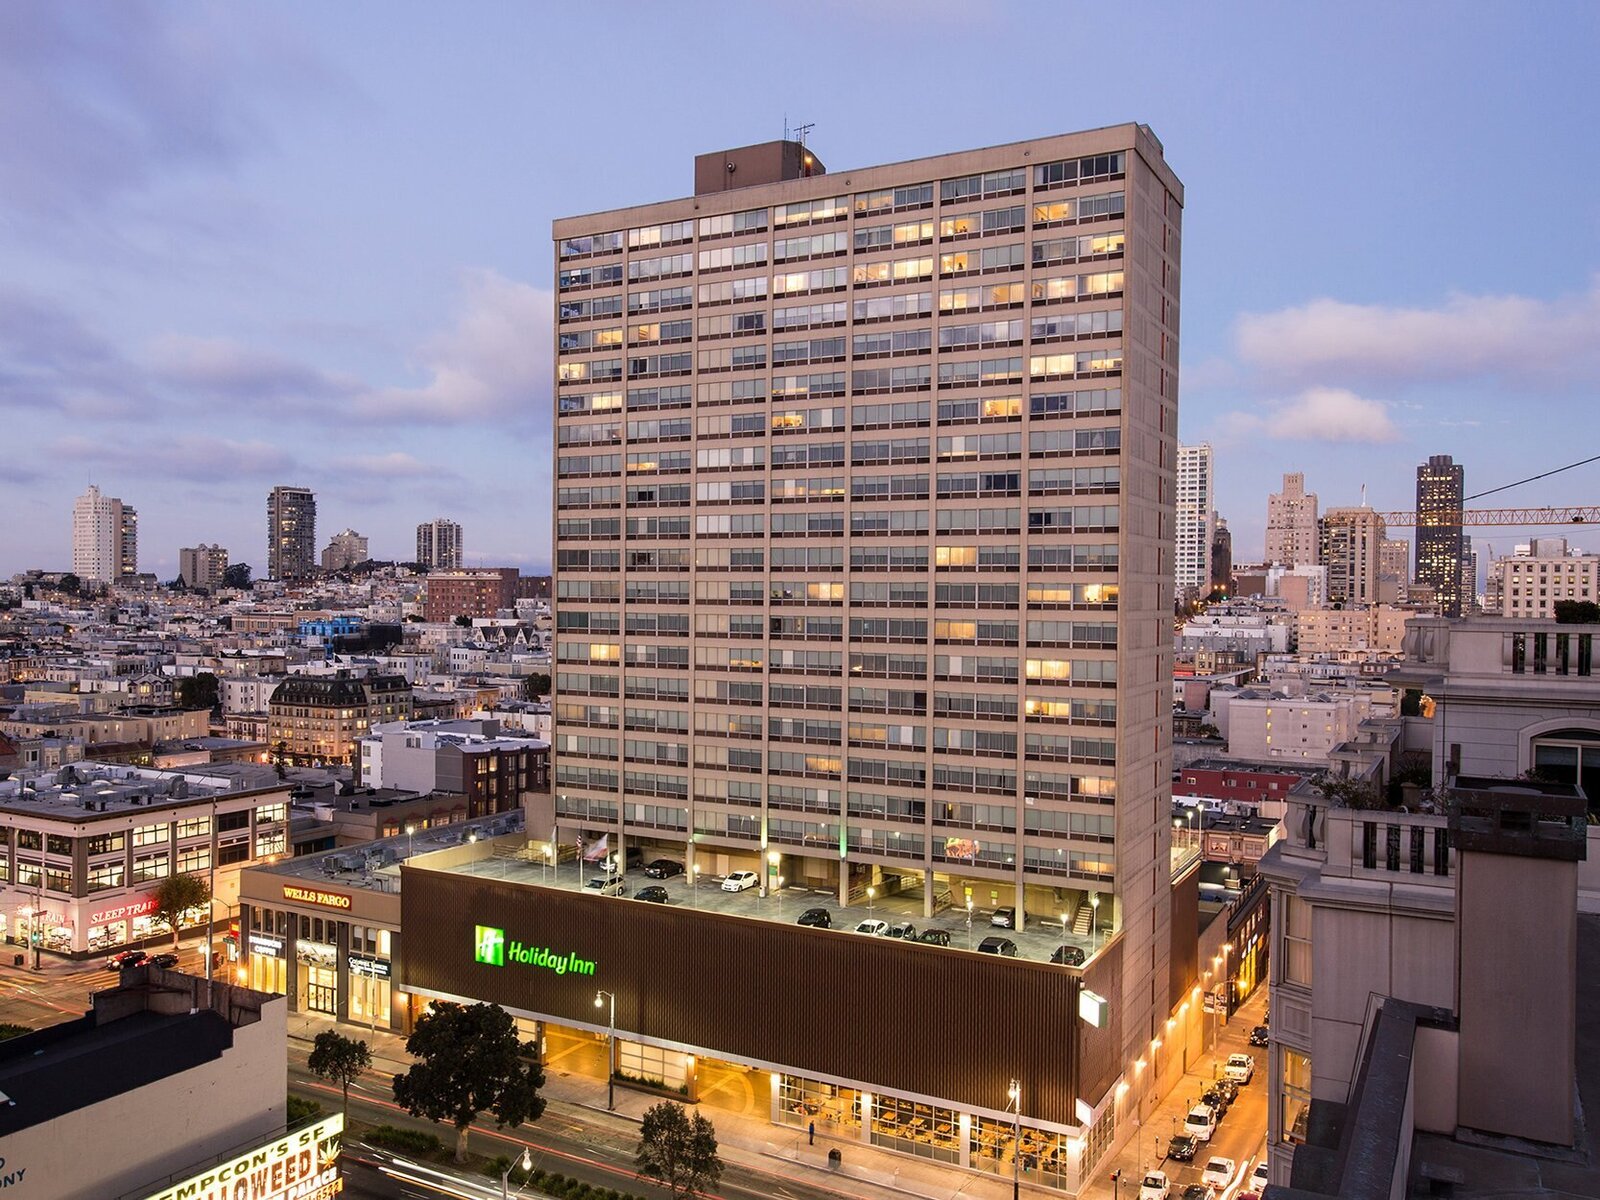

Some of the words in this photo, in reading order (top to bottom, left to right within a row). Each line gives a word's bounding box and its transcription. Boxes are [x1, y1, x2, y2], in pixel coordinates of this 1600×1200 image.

[283, 887, 316, 903] WELLS
[317, 891, 350, 908] FARGO
[91, 907, 125, 924] SLEEP
[127, 900, 159, 916] TRAI
[508, 941, 568, 974] Holiday
[568, 952, 595, 976] Inn
[299, 1126, 324, 1147] SF
